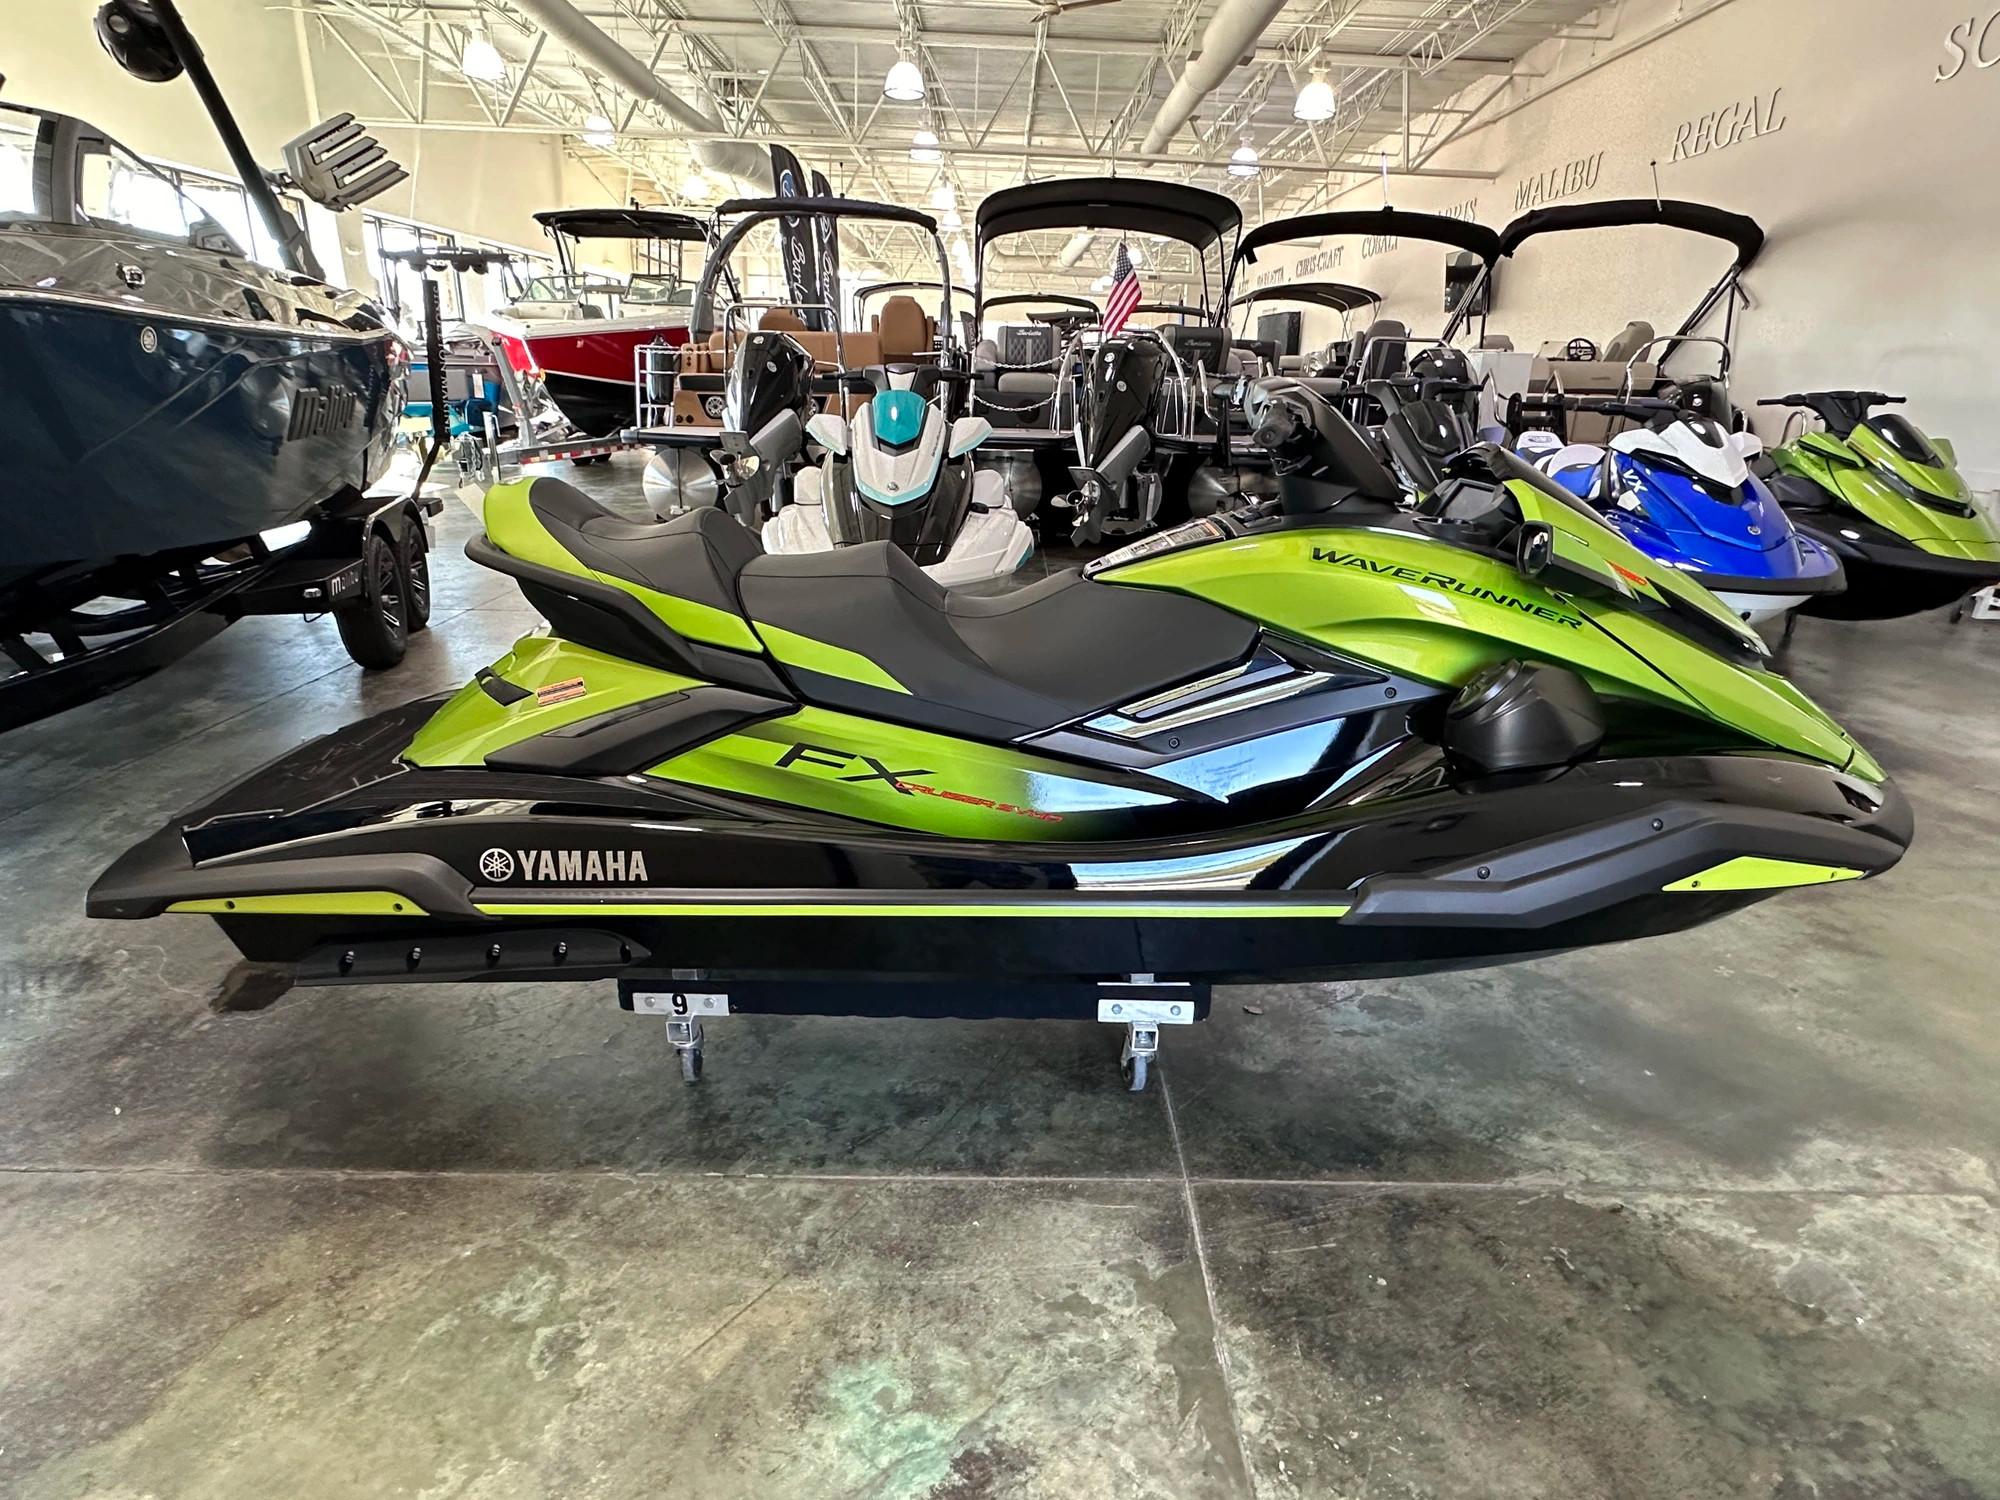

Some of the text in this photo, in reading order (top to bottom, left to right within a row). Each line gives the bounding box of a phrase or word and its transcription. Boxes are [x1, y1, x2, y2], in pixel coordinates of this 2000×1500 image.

[1667, 87, 1787, 165] REGAL
[1512, 151, 1604, 213] MALIBU
[1295, 245, 1345, 278] CHRIS-CRAFT
[1623, 469, 1648, 494] VX
[774, 742, 938, 796] FX
[517, 850, 648, 881] YAMAHA
[672, 992, 688, 1015] 9
